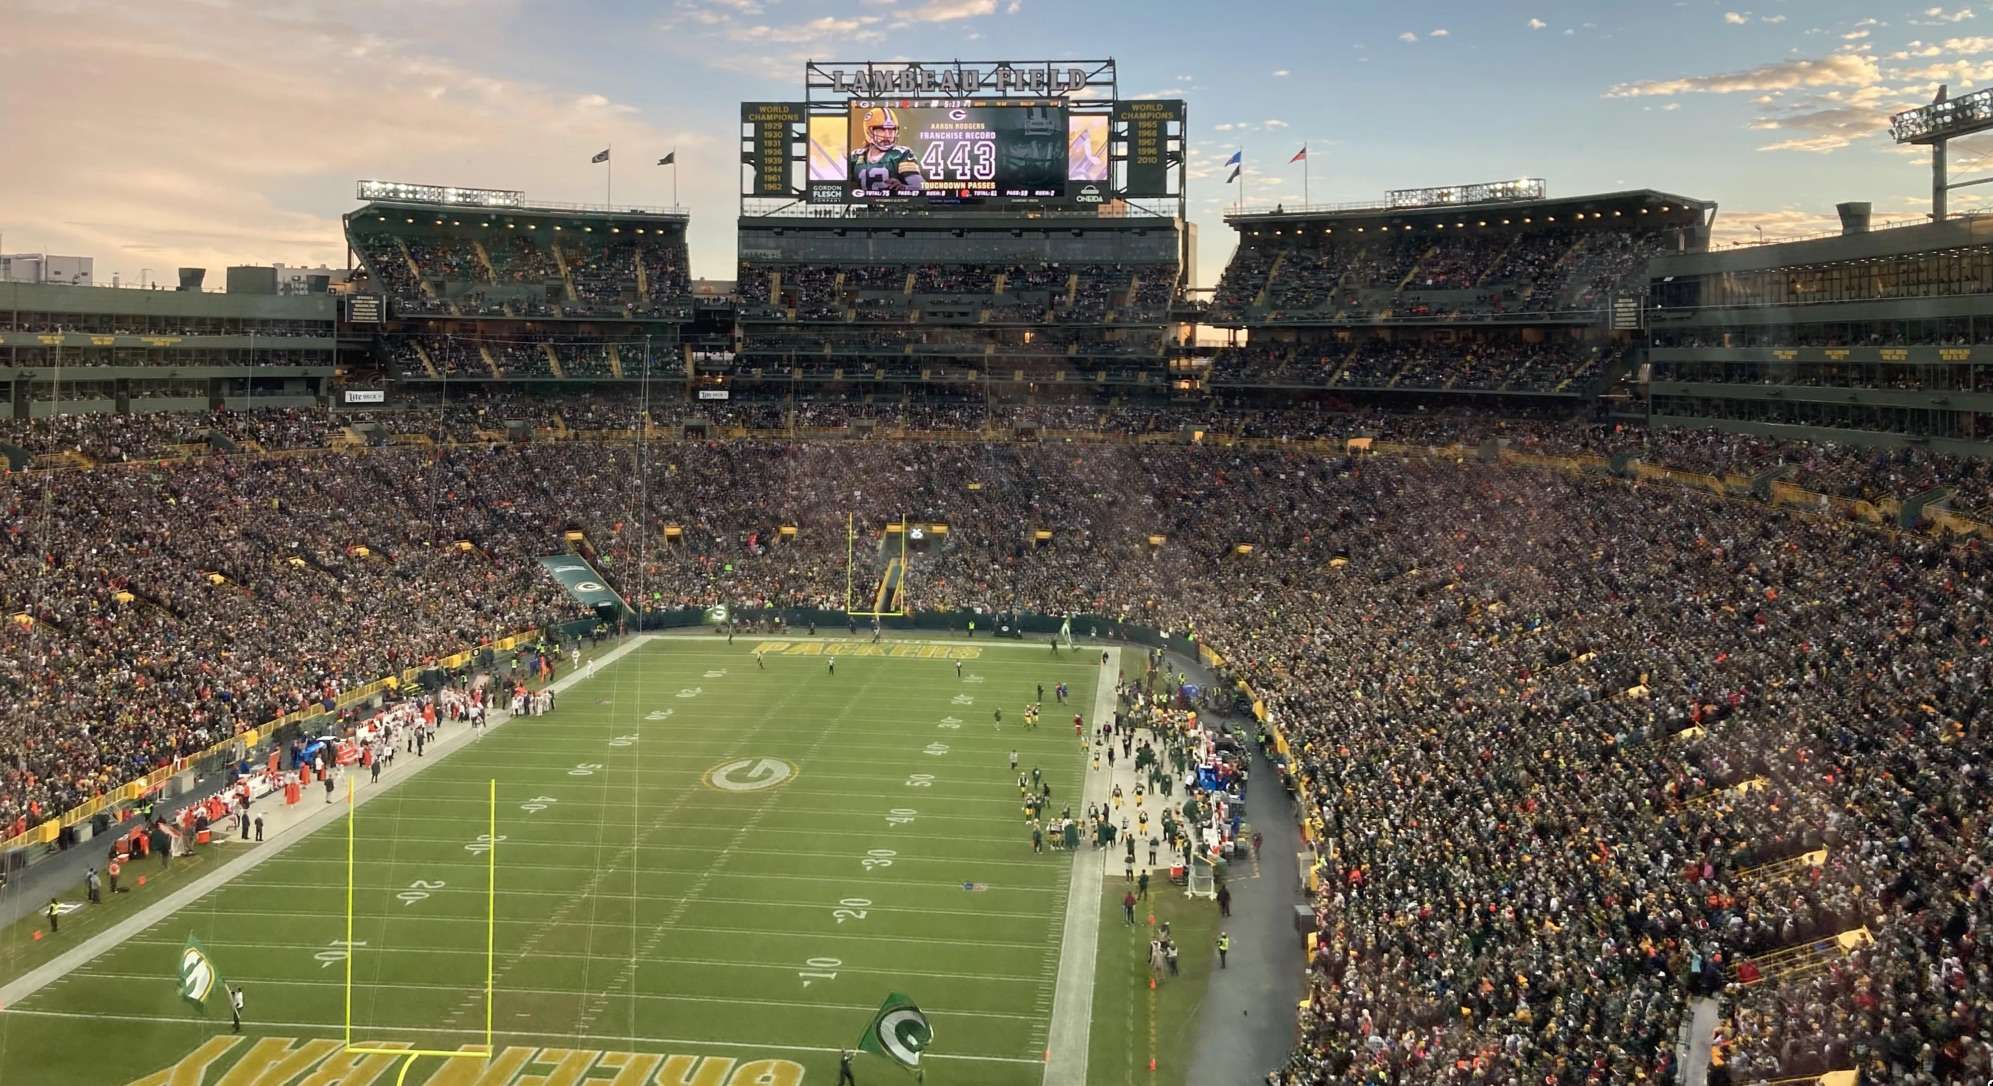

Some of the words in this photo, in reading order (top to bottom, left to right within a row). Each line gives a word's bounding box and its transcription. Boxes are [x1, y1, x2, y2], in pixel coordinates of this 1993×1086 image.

[833, 70, 980, 92] LAMBEAU
[995, 69, 1087, 91] FIELD
[759, 105, 789, 113] WORLD
[920, 141, 996, 180] 443
[921, 181, 966, 189] TOUCHDOWN
[967, 181, 996, 189] PASSES
[1076, 195, 1104, 203] ONEIDA
[751, 641, 983, 659] PACKERS
[567, 763, 603, 776] 50
[711, 758, 791, 791] G
[905, 774, 935, 787] 50
[520, 796, 557, 810] 40
[885, 808, 918, 824] 40
[464, 834, 507, 852] 30
[862, 849, 897, 867] 30
[396, 880, 446, 900] 20
[833, 898, 872, 919] 20
[314, 940, 367, 961] 10
[799, 957, 842, 980] 10
